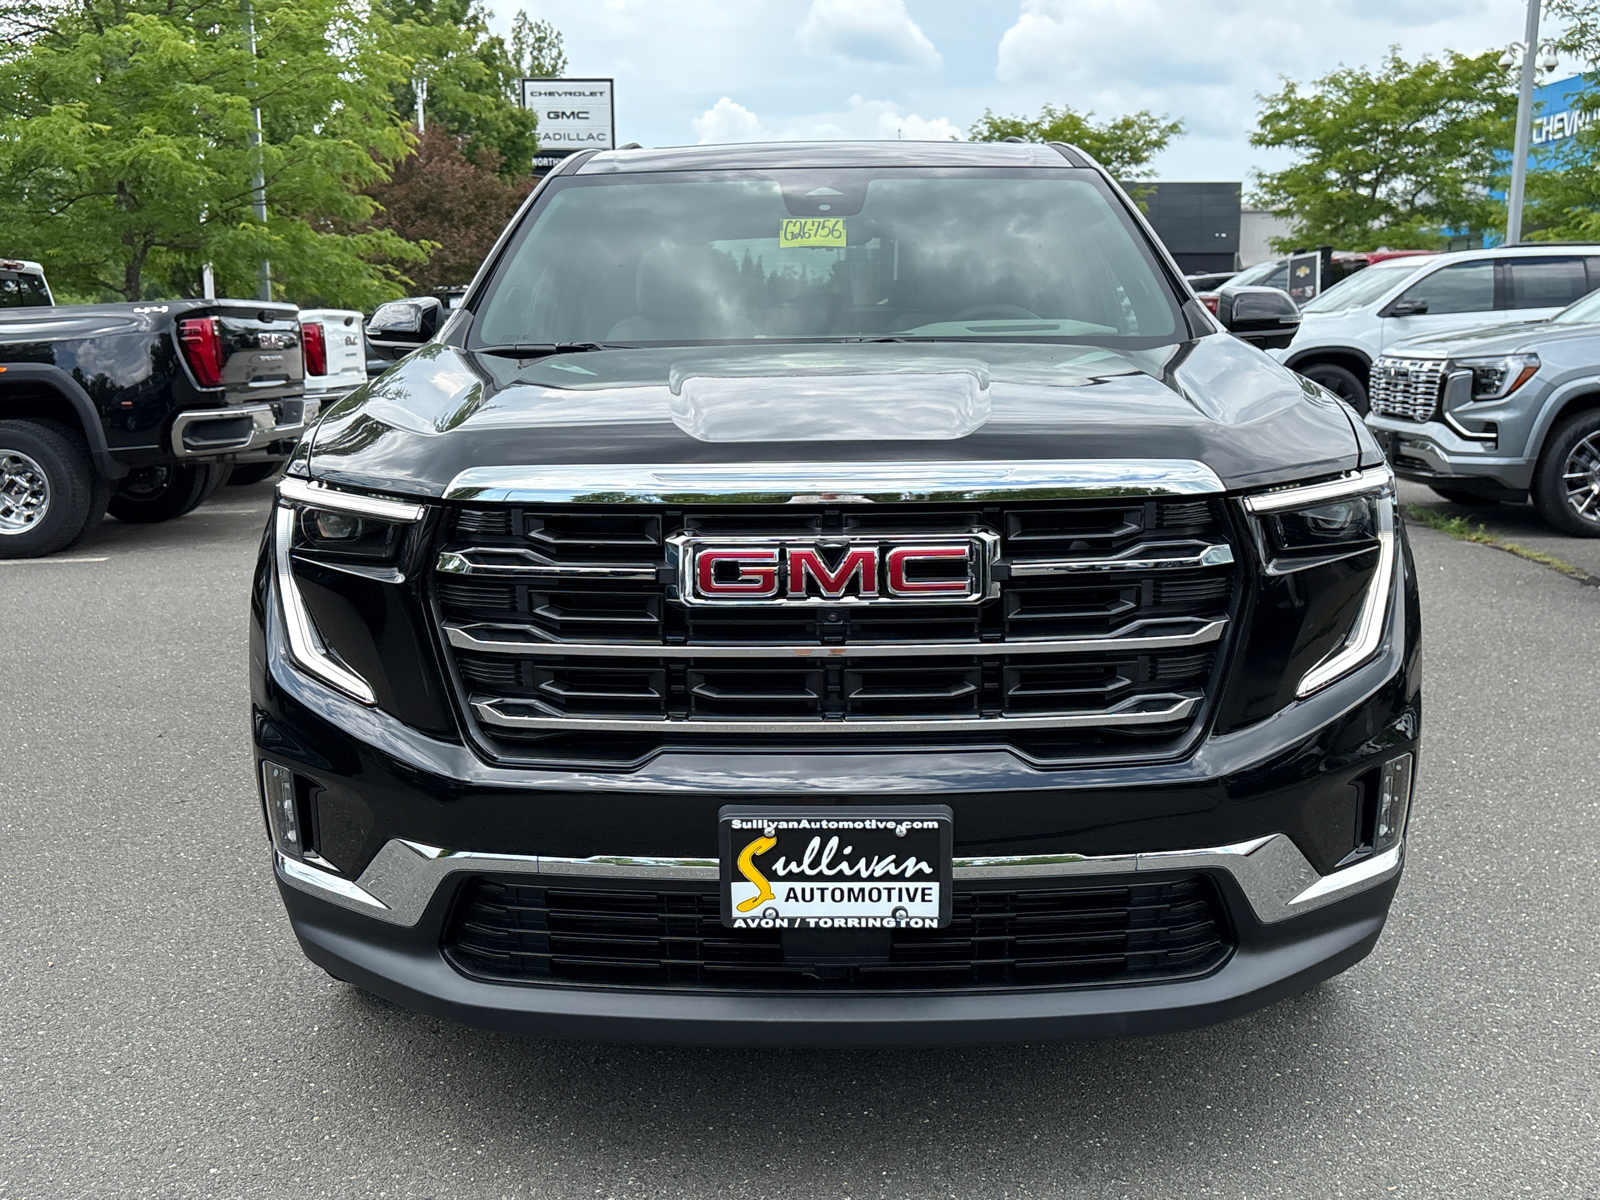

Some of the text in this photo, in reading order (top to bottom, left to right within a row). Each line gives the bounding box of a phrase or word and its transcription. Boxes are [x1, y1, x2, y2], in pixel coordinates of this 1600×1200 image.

[547, 111, 590, 120] GMC
[696, 546, 971, 598] GMC
[731, 819, 939, 829] SullivanAutomotive.com
[736, 836, 933, 913] Sullivan
[784, 887, 934, 903] AUTOMOTIVE
[733, 918, 789, 928] AVON
[806, 917, 939, 928] TORRINGTON
